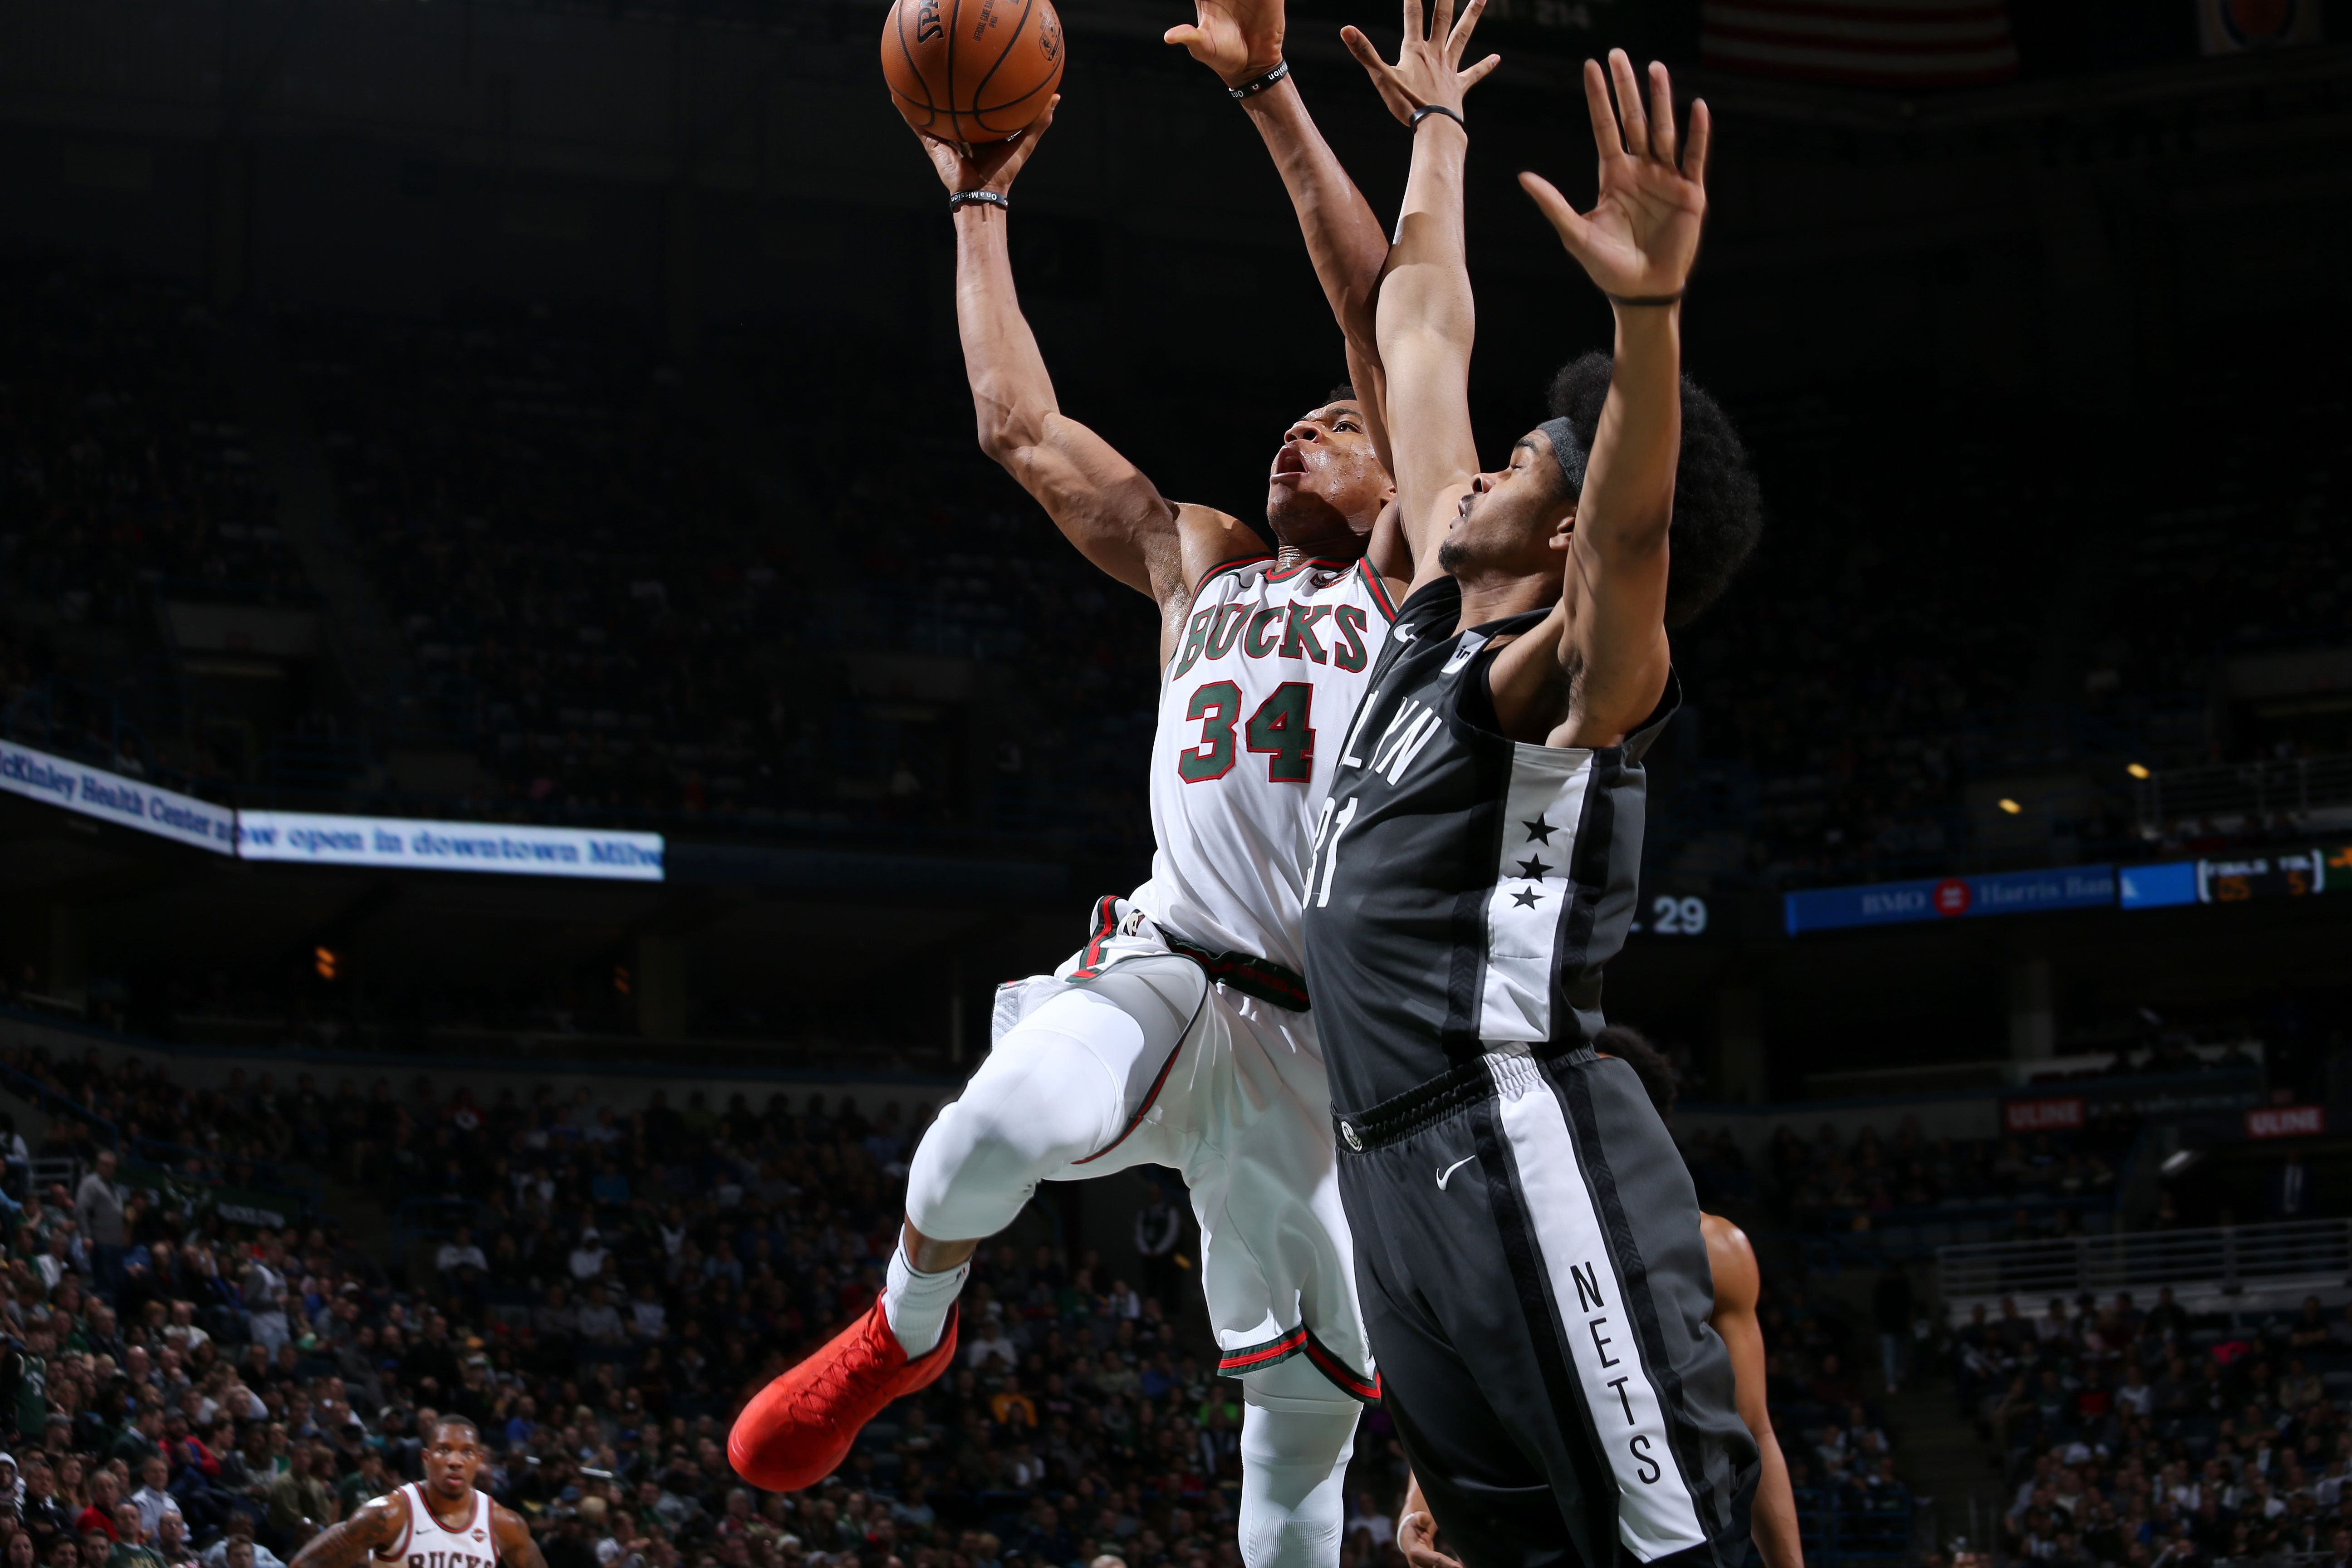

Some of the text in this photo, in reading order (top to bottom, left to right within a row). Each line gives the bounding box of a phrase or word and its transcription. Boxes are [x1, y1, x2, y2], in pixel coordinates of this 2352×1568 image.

[986, 192, 997, 201] On
[1172, 598, 1368, 681] BUCKS
[1178, 680, 1316, 784] 34
[0, 751, 76, 801] cKinley
[81, 774, 144, 817] Health
[150, 794, 211, 836] Center
[287, 828, 364, 855] open
[374, 825, 403, 853] in
[412, 829, 580, 862] downtown
[1980, 881, 2060, 905] Harris
[1653, 895, 1707, 935] 29
[2009, 1101, 2080, 1128] ULINE
[2251, 1107, 2321, 1134] ULINE
[1570, 1261, 1661, 1484] NETS
